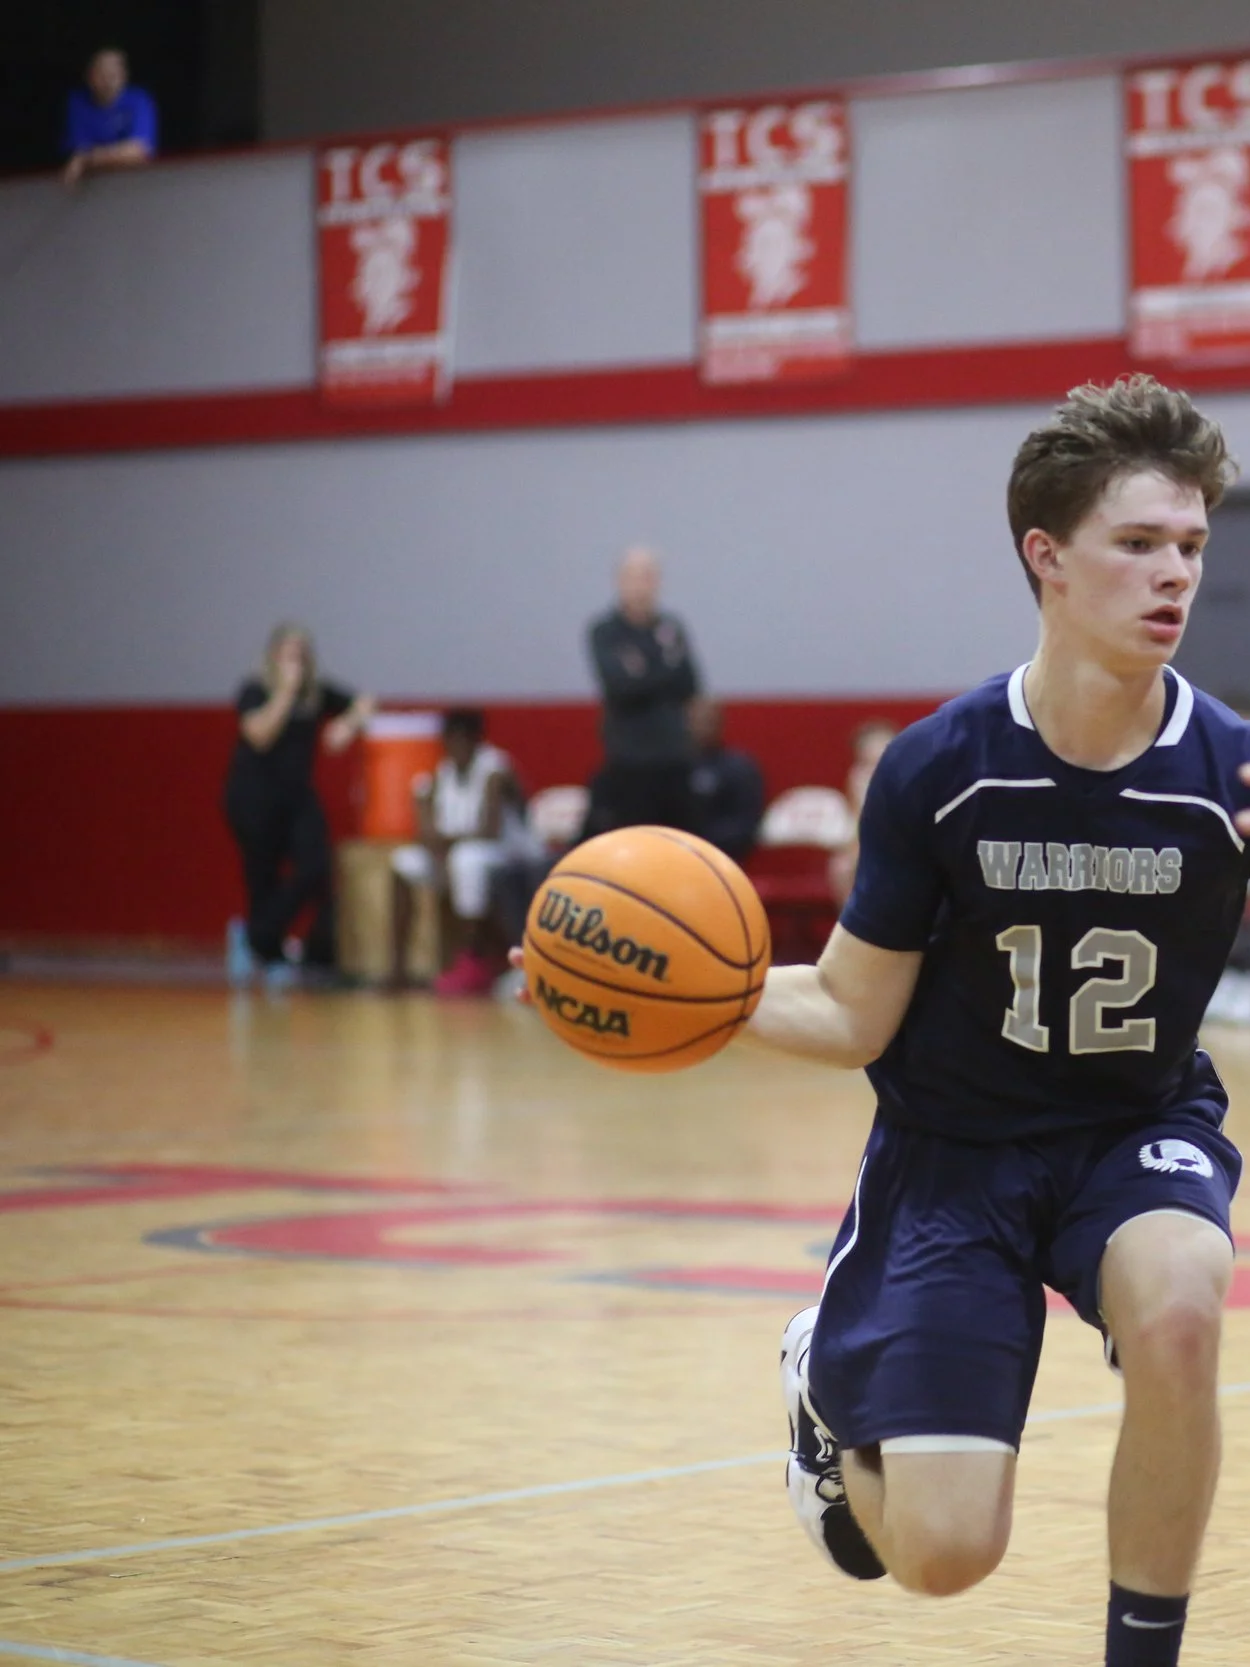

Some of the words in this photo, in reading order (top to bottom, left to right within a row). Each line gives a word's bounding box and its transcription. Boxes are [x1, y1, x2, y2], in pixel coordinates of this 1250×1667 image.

[324, 141, 444, 204] TCS
[706, 102, 844, 178] TCS
[977, 840, 1183, 895] WARRIORS
[537, 888, 670, 982] Wilson
[536, 974, 630, 1038] NCAA
[996, 925, 1157, 1054] 12
